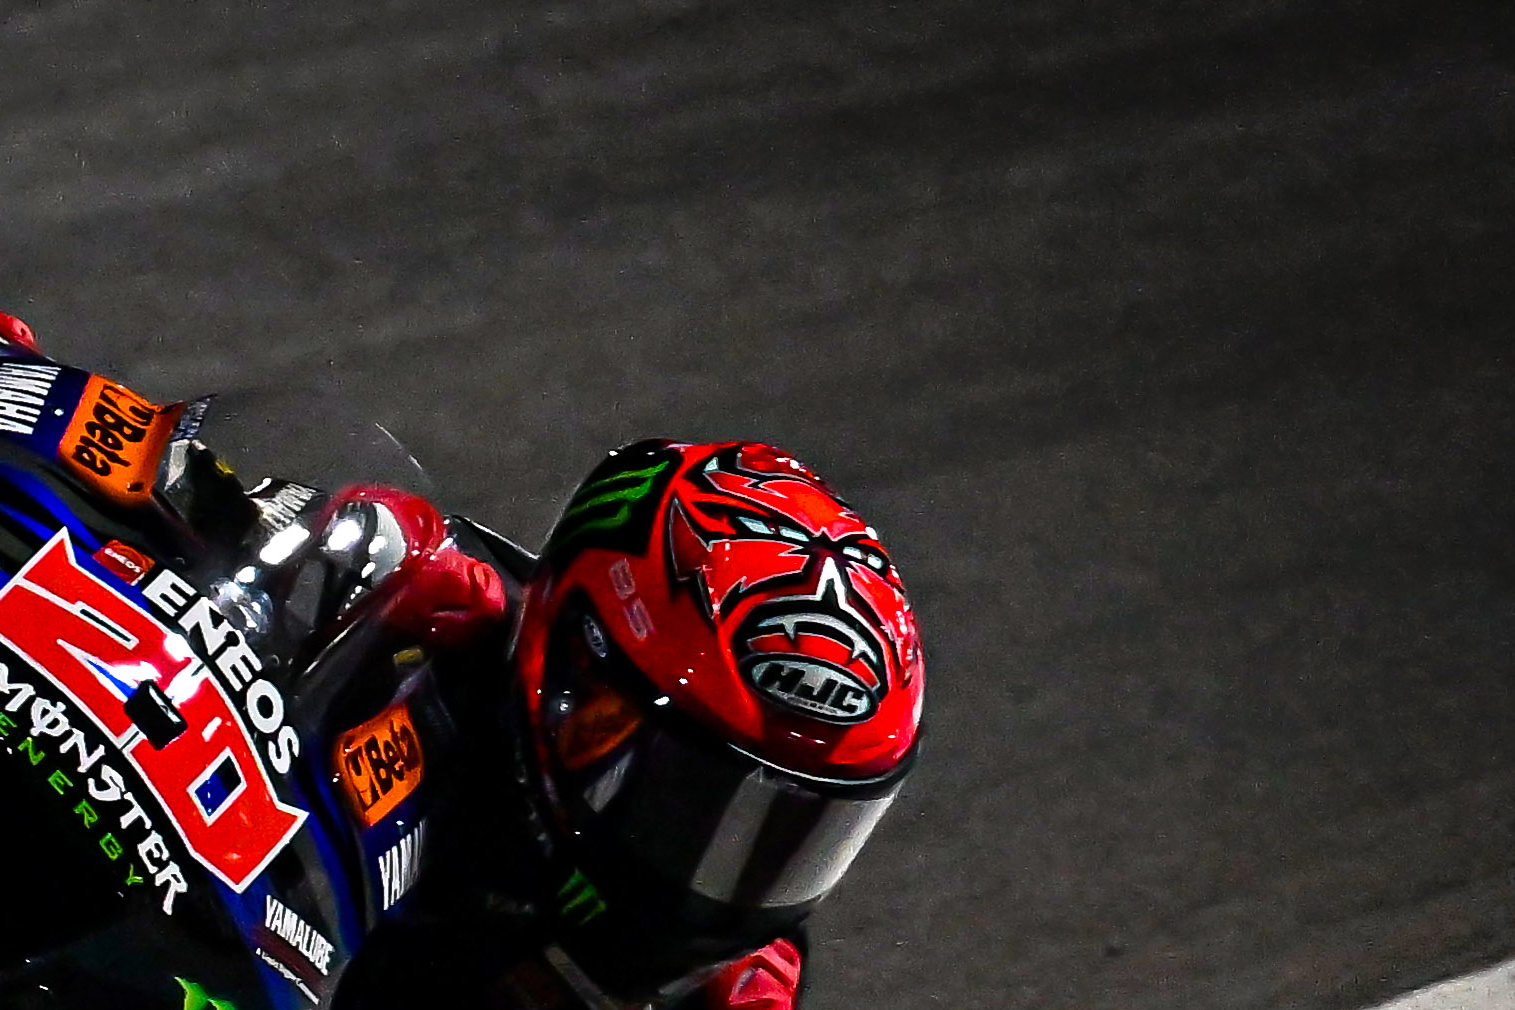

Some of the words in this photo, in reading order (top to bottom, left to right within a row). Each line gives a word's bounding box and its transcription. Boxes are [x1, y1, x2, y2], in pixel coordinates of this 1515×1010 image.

[142, 569, 300, 774] ENEOS
[756, 662, 865, 714] HJC
[265, 894, 336, 976] YAMALUBE
